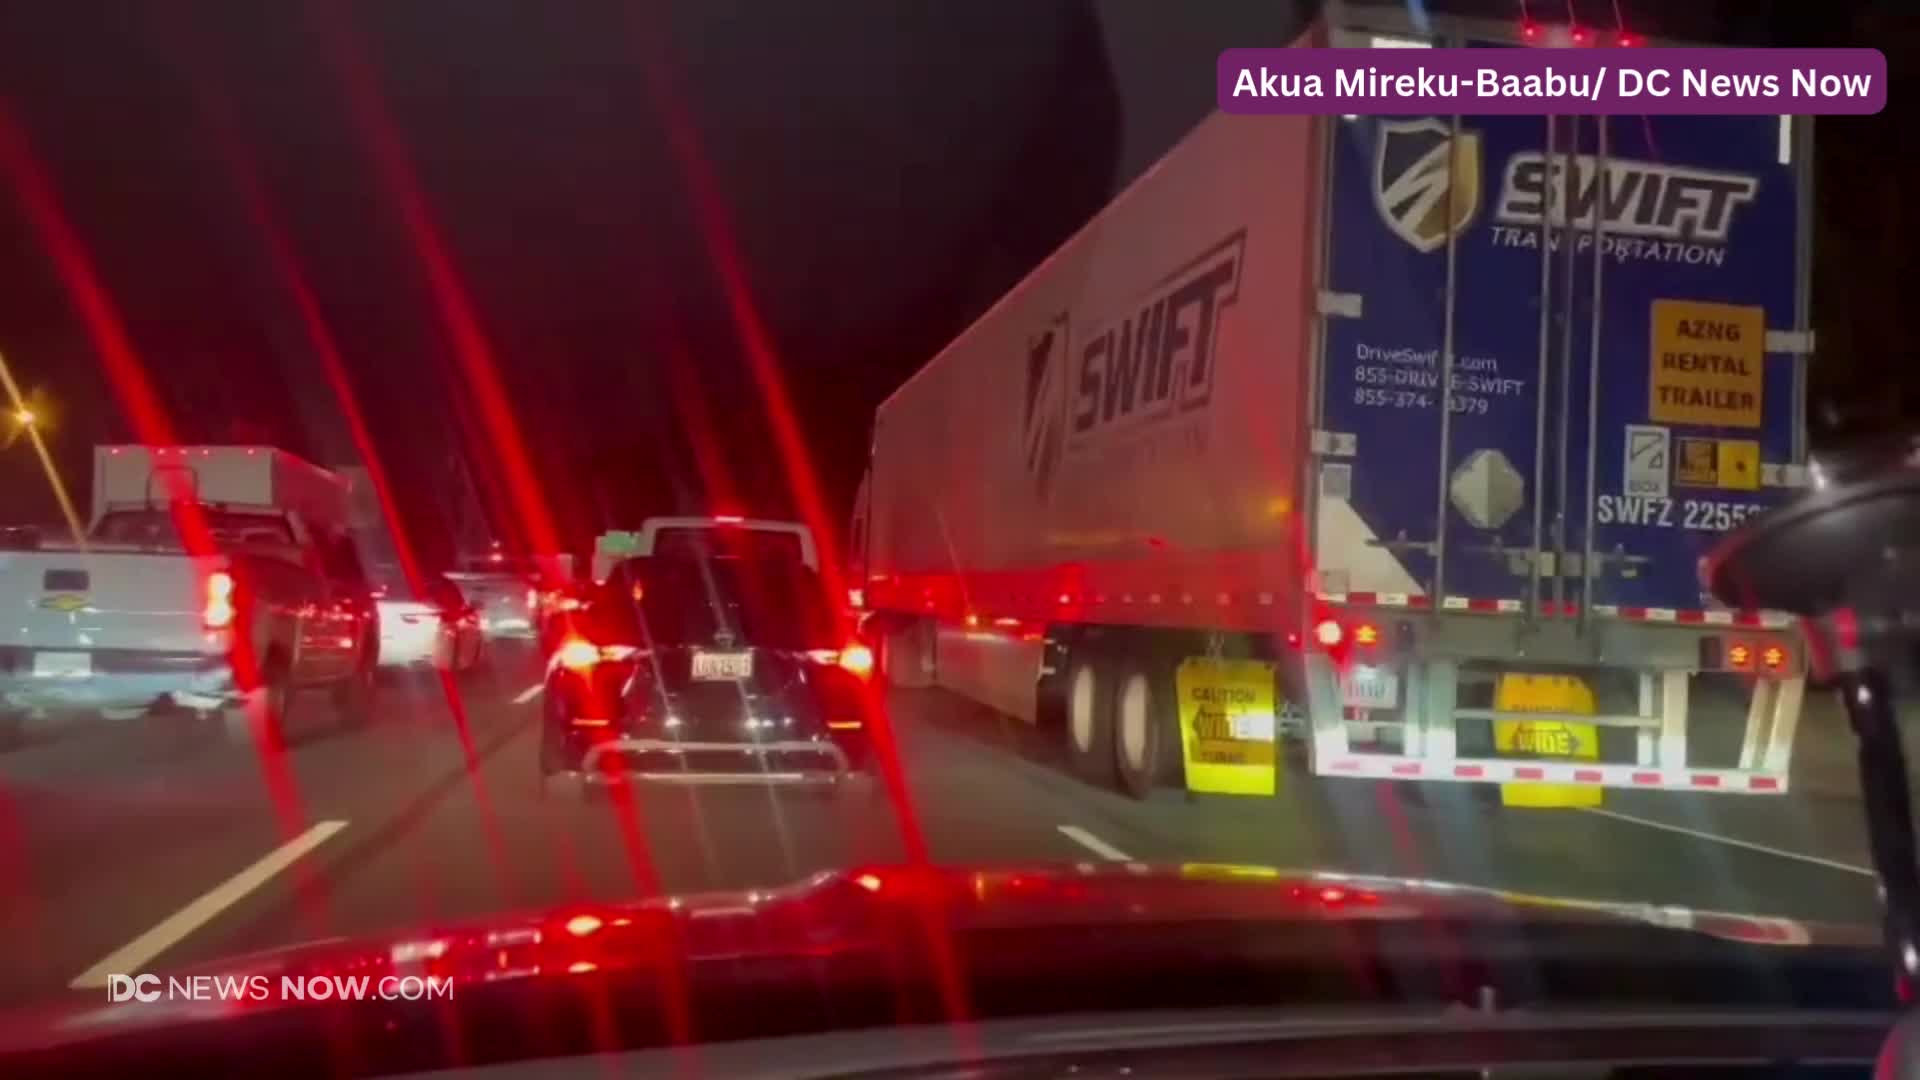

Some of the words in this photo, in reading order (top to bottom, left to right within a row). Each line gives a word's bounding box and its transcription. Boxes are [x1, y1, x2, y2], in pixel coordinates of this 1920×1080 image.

[1502, 155, 1755, 236] SWIFT
[1491, 226, 1725, 265] TRANPORTATION
[1073, 240, 1241, 438] SWIFT
[1678, 319, 1741, 342] AZNG
[1356, 343, 1498, 372] DriveSwif.com
[1663, 352, 1751, 376] RENTAL
[1658, 386, 1753, 409] TRAILER
[1597, 495, 1673, 527] SWFZ
